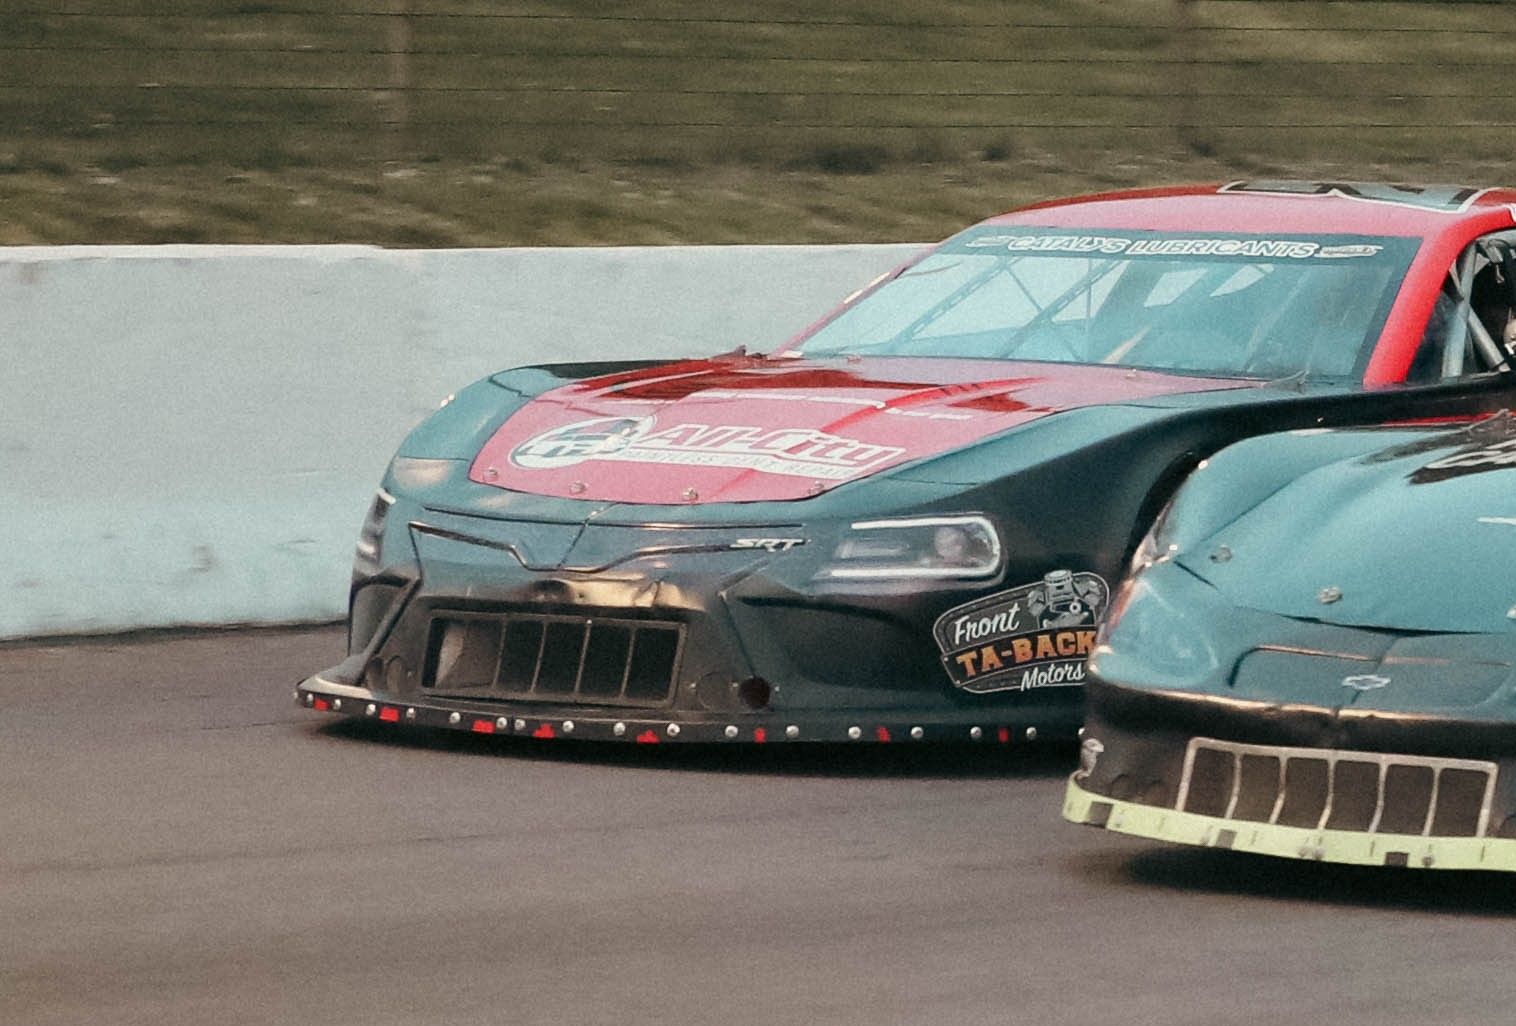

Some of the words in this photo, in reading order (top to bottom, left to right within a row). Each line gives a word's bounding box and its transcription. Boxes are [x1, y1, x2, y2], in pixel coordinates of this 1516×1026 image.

[729, 538, 804, 553] SRT
[954, 602, 1021, 645] Front
[955, 630, 1097, 677] TA-BACK
[1020, 662, 1085, 692] Motors
